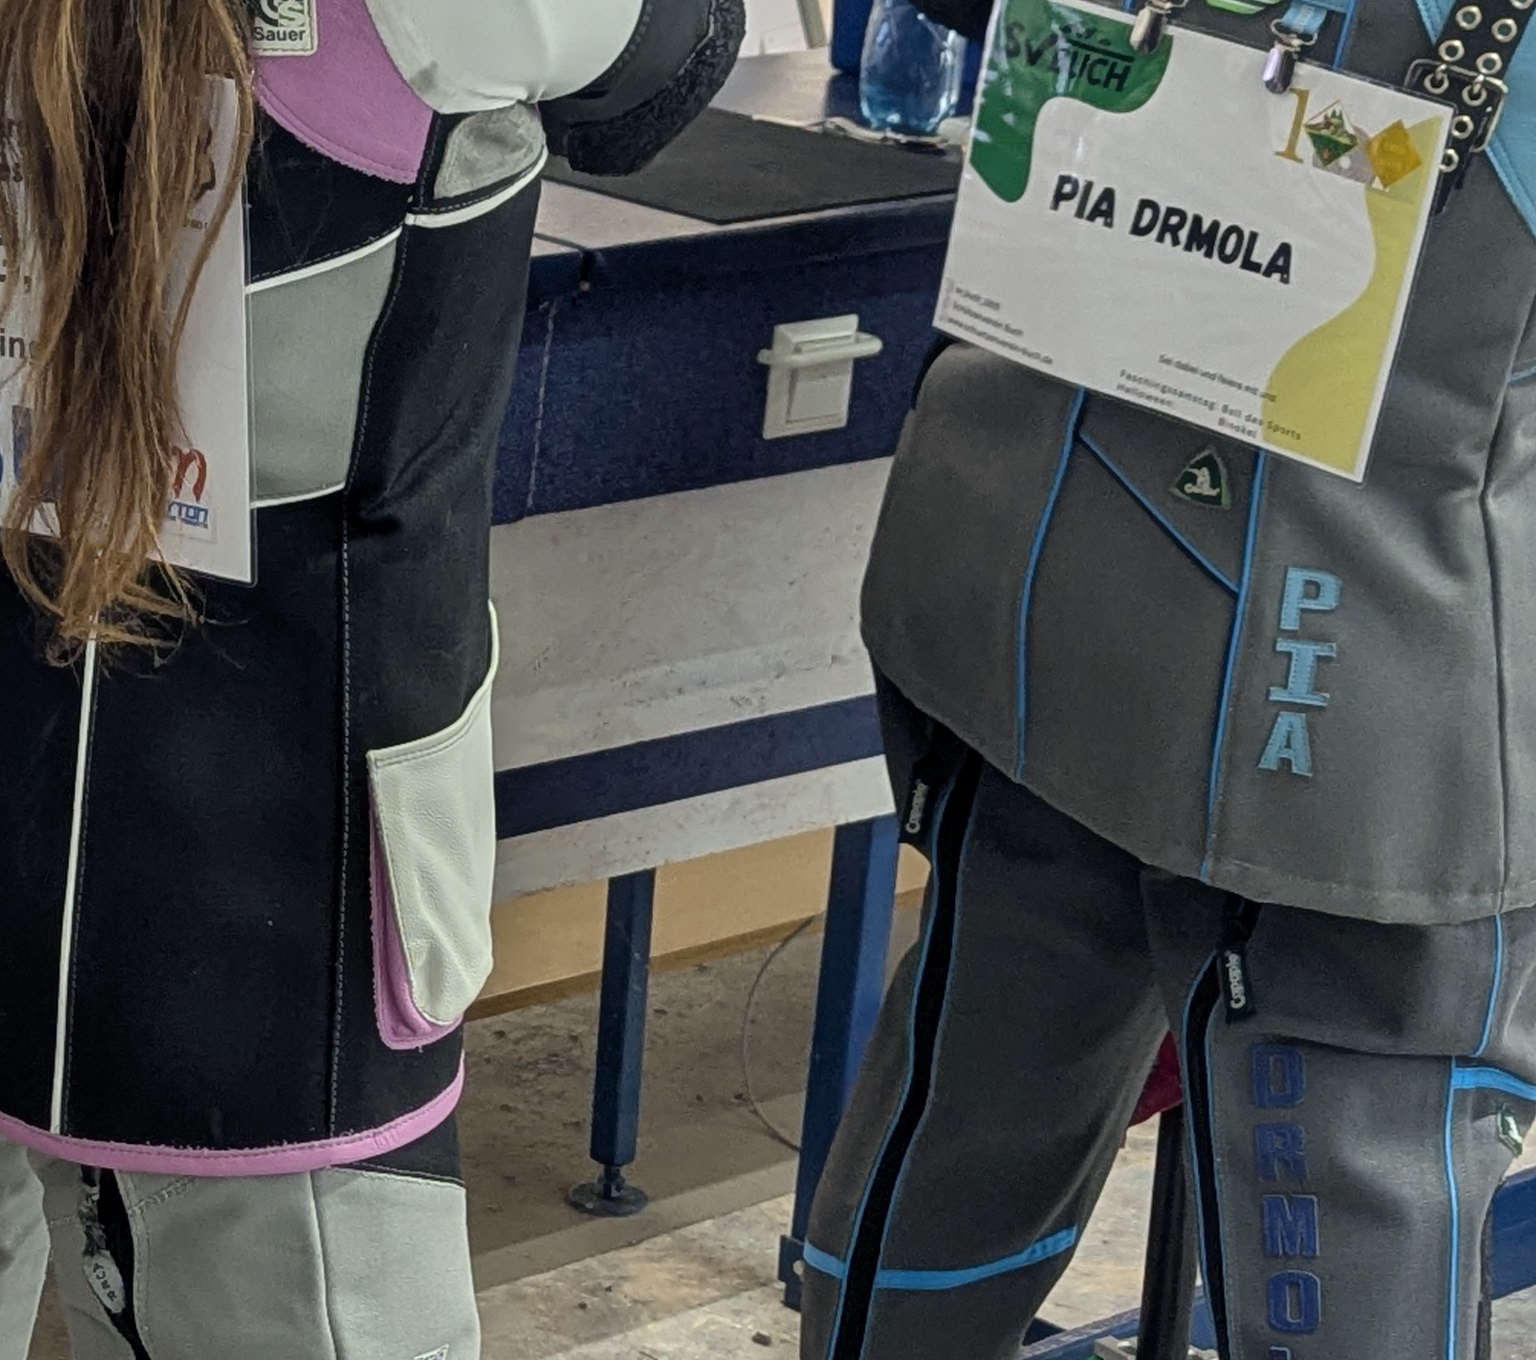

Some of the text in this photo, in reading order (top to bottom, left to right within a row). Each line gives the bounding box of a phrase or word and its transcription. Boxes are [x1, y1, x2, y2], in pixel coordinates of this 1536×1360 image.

[254, 26, 306, 41] Sauer
[1050, 174, 1293, 285] PIA DRMOLA
[1266, 419, 1302, 441] Sports
[1257, 566, 1343, 777] PIA
